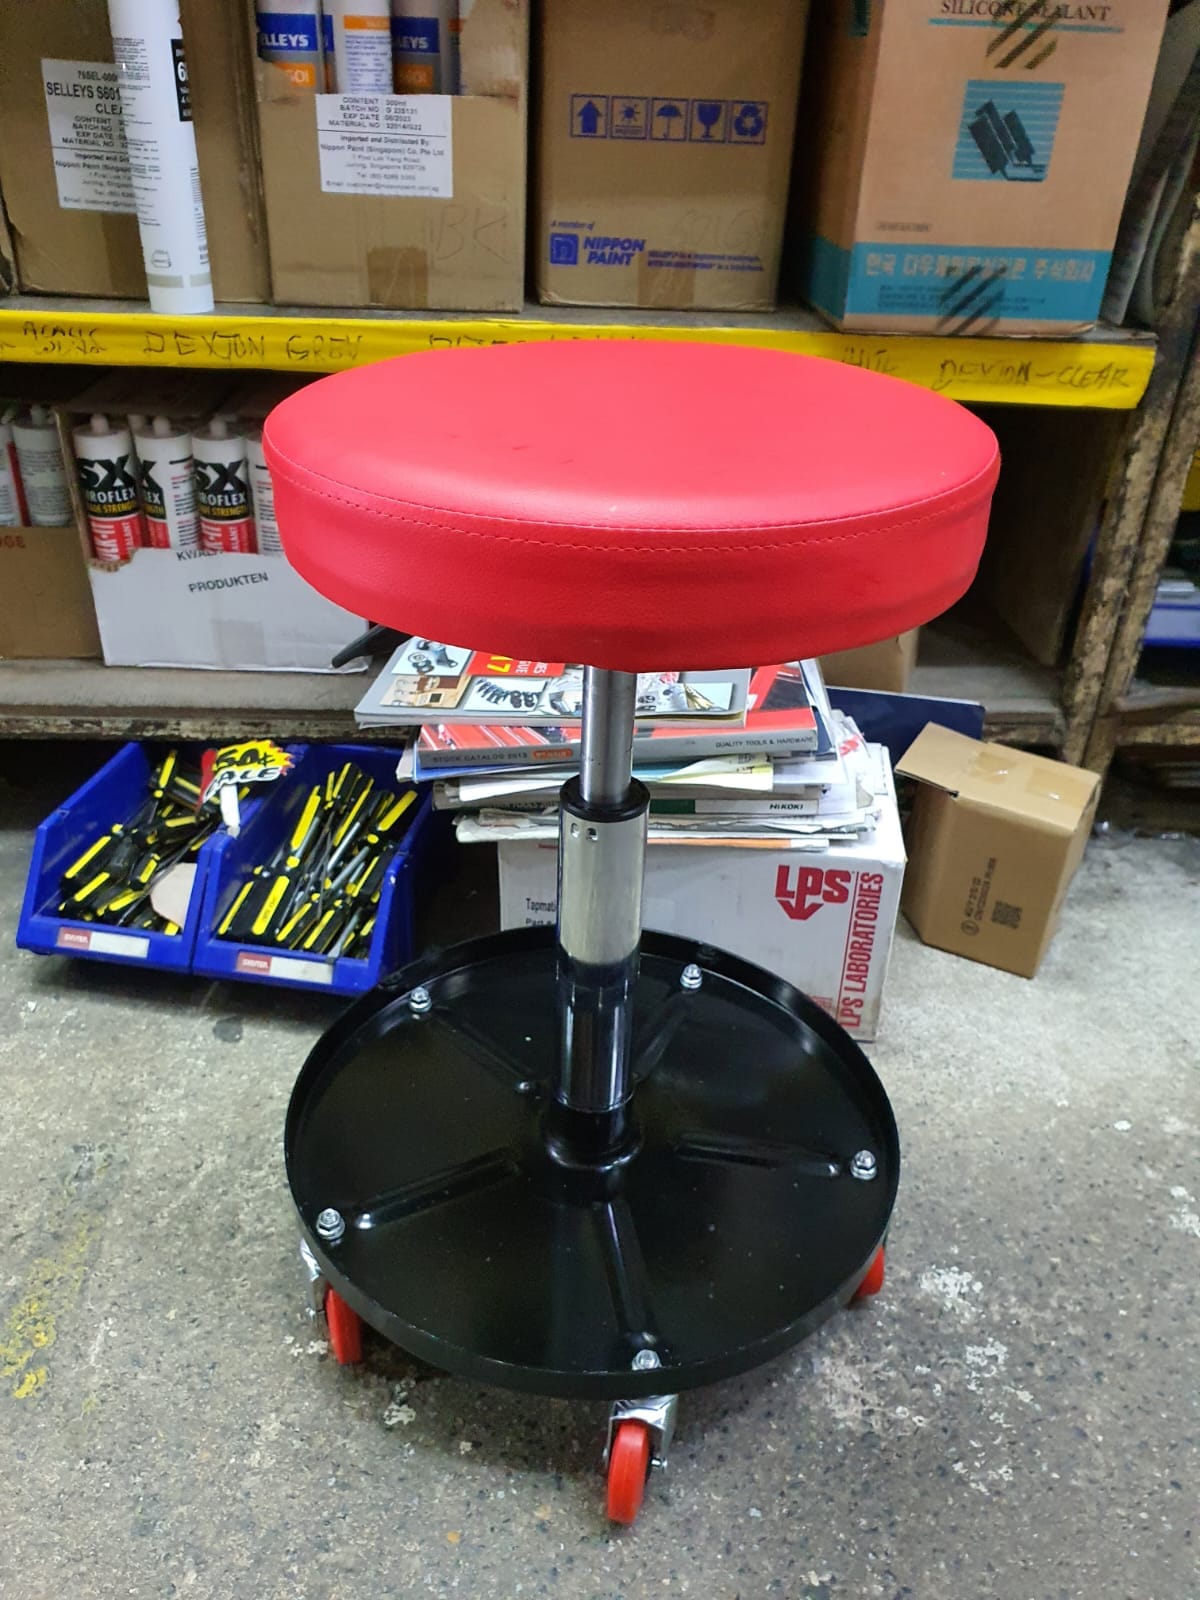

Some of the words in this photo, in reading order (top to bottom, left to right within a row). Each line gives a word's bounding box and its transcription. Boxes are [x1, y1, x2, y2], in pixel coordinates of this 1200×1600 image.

[46, 81, 94, 98] SELLEYS
[340, 104, 366, 112] BATCH
[342, 96, 379, 105] CONTENT
[328, 119, 367, 128] MATERIAL
[583, 236, 647, 252] NIPPON
[587, 251, 636, 266] PAINT
[188, 571, 269, 593] PRODUKTEN
[715, 741, 743, 749] QUALITY
[777, 736, 814, 745] HARDWARE
[464, 753, 504, 762] CATALOG
[775, 864, 852, 911] LPS
[844, 872, 884, 993] LABORATORIES
[838, 998, 865, 1028] LPS
